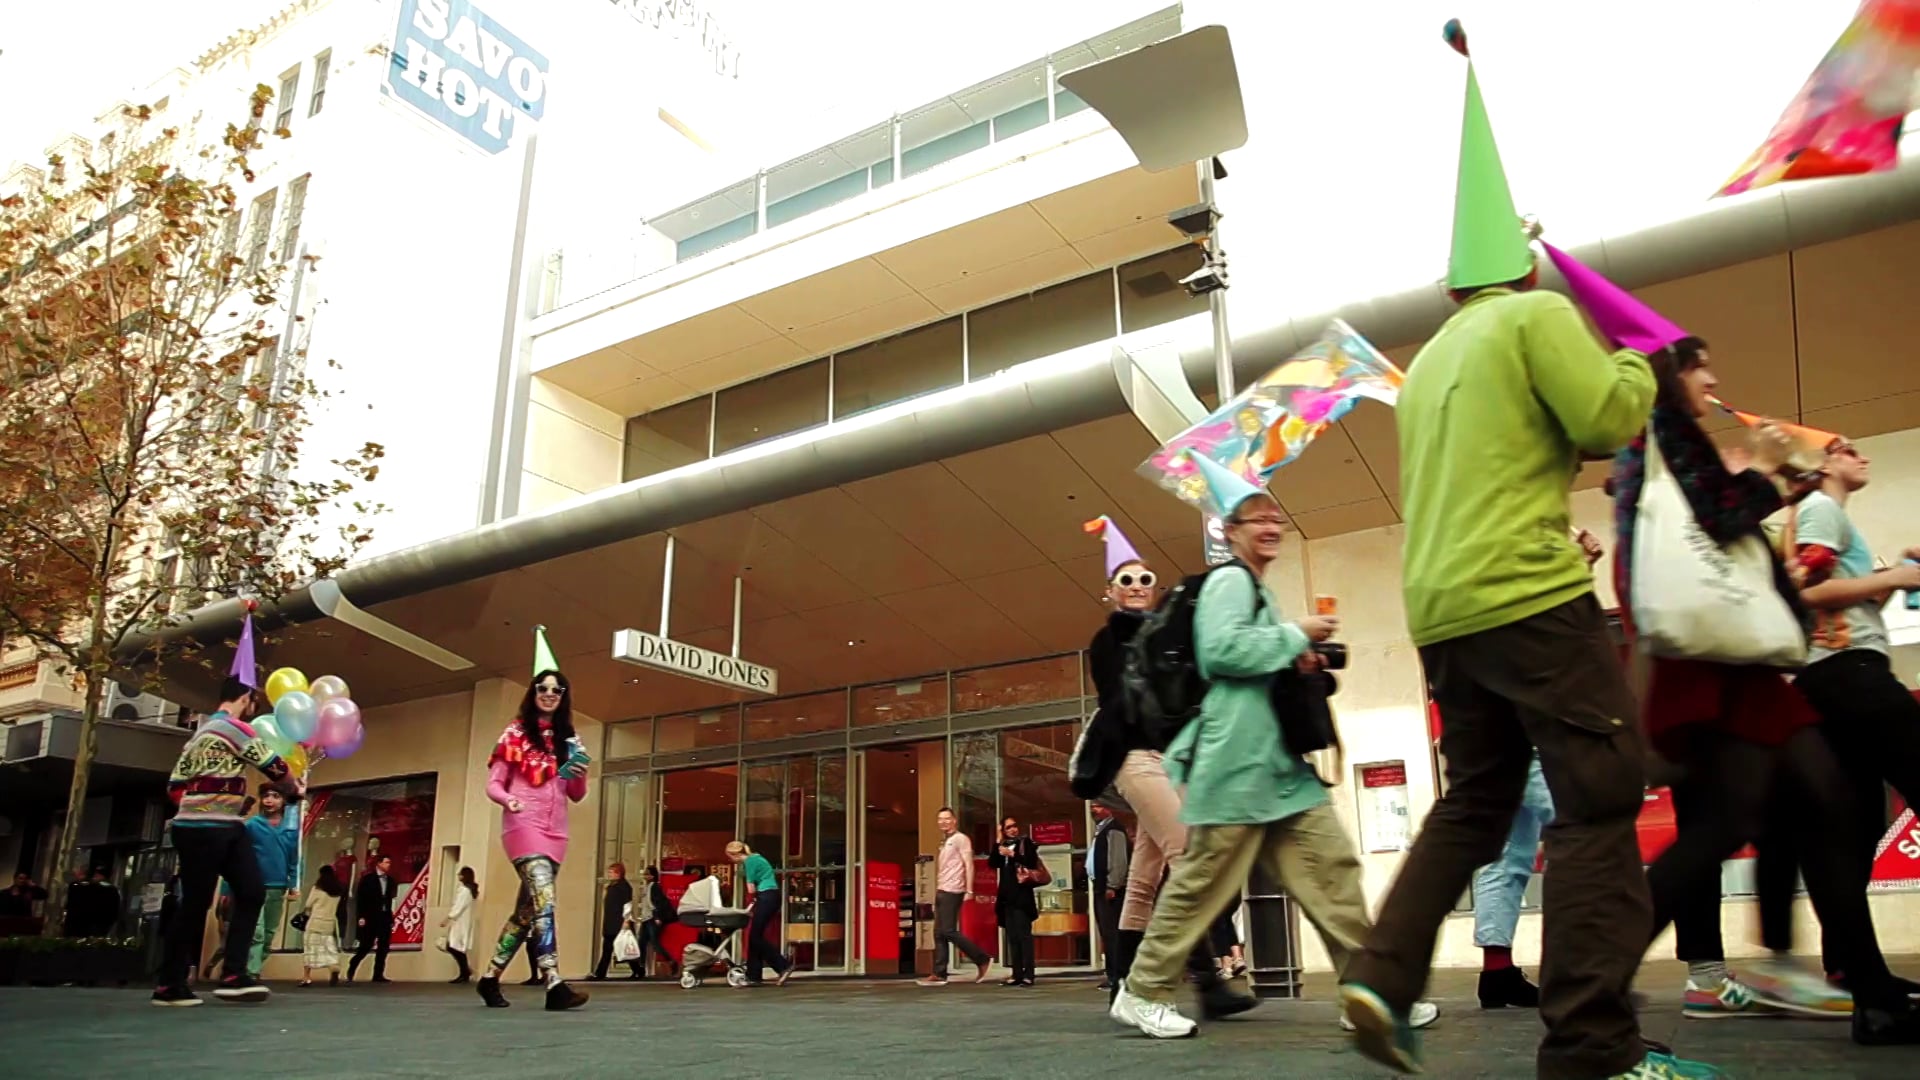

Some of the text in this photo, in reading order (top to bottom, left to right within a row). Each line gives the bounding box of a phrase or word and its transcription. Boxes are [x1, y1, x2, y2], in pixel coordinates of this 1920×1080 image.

[639, 635, 770, 688] DAVID JONES
[1898, 820, 1920, 859] SA
